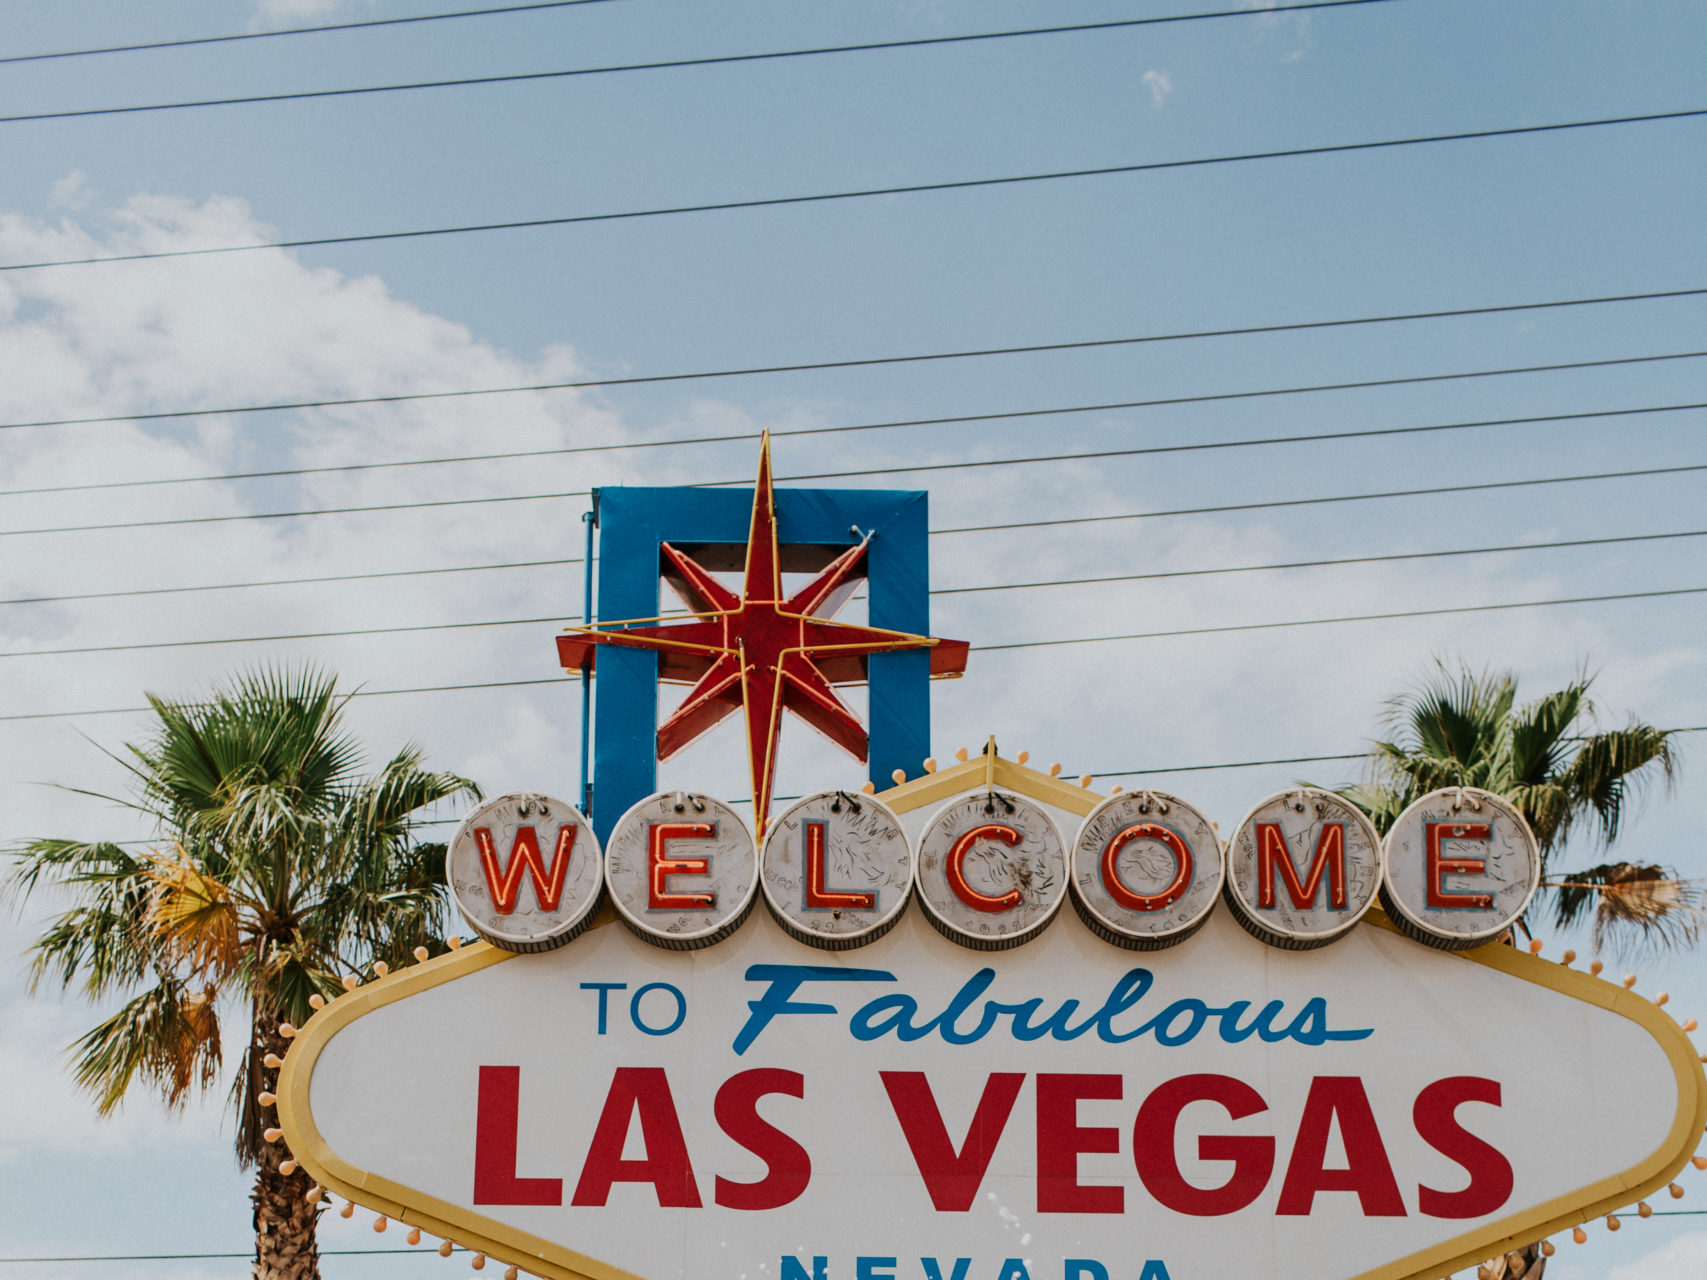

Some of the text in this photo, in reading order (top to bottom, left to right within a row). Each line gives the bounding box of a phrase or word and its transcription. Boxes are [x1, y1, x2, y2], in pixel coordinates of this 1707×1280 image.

[472, 821, 1495, 916] WELCOME
[580, 964, 1374, 1057] TO Fabulous
[474, 1065, 1516, 1220] LAS VEGAS
